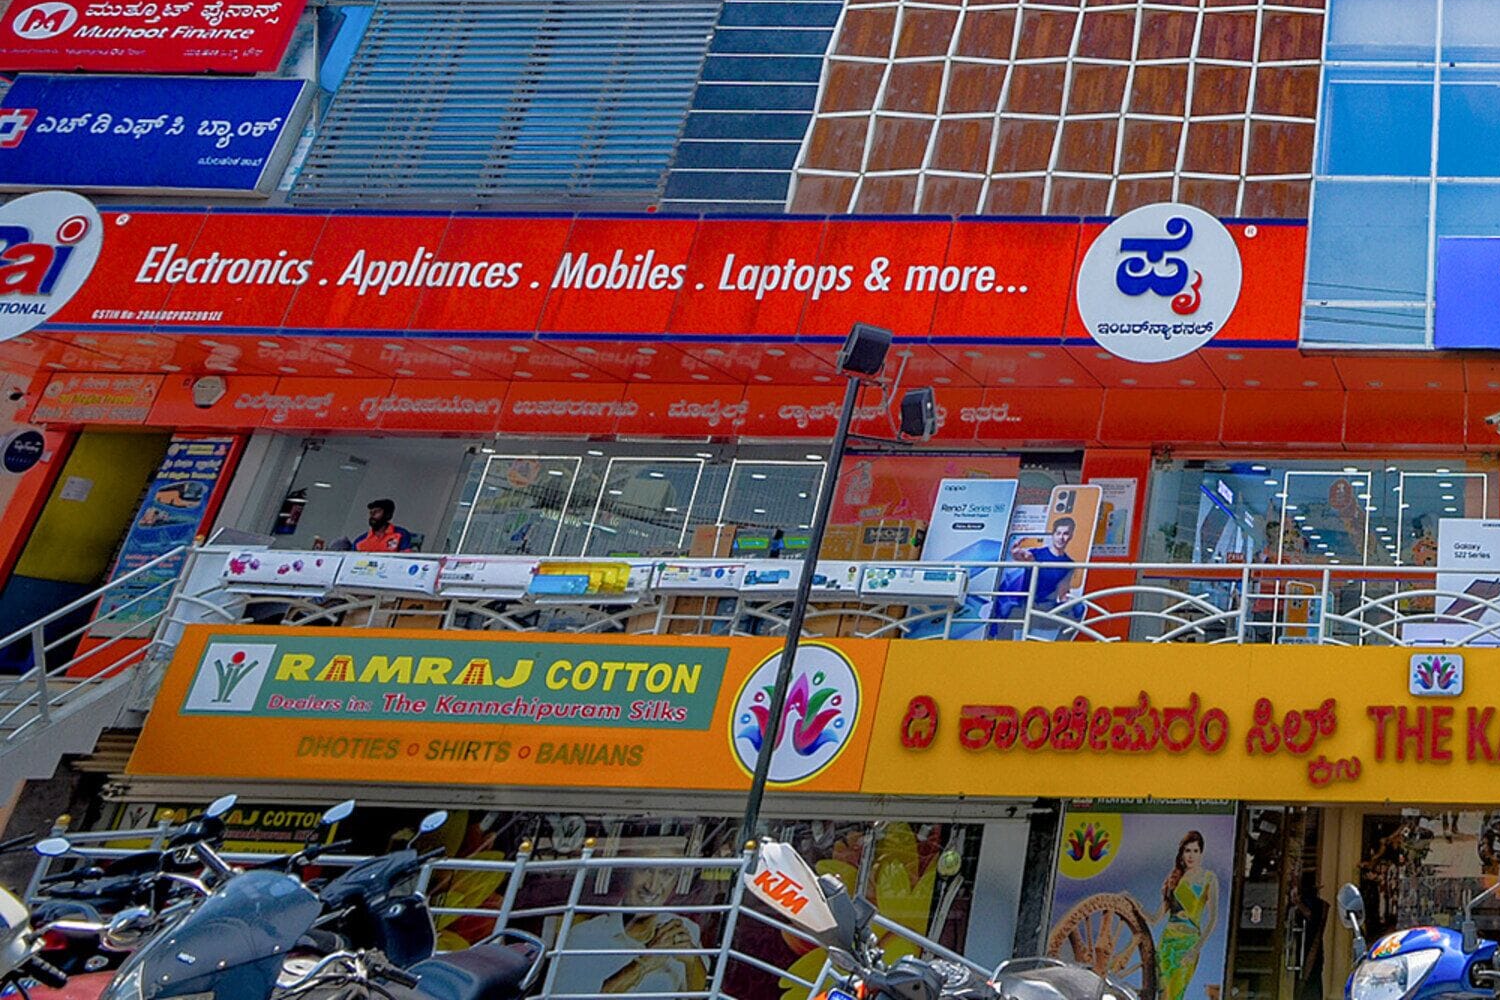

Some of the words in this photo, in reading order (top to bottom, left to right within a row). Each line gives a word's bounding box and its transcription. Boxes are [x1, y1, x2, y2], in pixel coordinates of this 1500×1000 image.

[73, 25, 168, 39] Muthoot
[170, 26, 255, 40] Finance
[135, 243, 315, 287] Electronics
[336, 249, 523, 296] Appliances
[551, 249, 688, 291] Mobiles
[718, 253, 853, 300] Laptops
[863, 256, 892, 292] &
[904, 266, 1029, 294] more...
[1453, 542, 1481, 551] Galaxy
[1468, 551, 1491, 559] Series
[274, 653, 535, 687] RAMRAJ
[545, 660, 701, 694] COTTON
[267, 693, 341, 712] Dealers
[382, 693, 426, 715] The
[433, 696, 621, 722] Kannchipuram
[629, 700, 688, 722] Silks
[901, 694, 939, 751] ದಿ
[297, 735, 401, 760] DHOTIES
[424, 738, 511, 762] SHIRTS
[535, 743, 644, 767] BANIANS
[1367, 705, 1453, 763] THE
[753, 870, 809, 915] KTM
